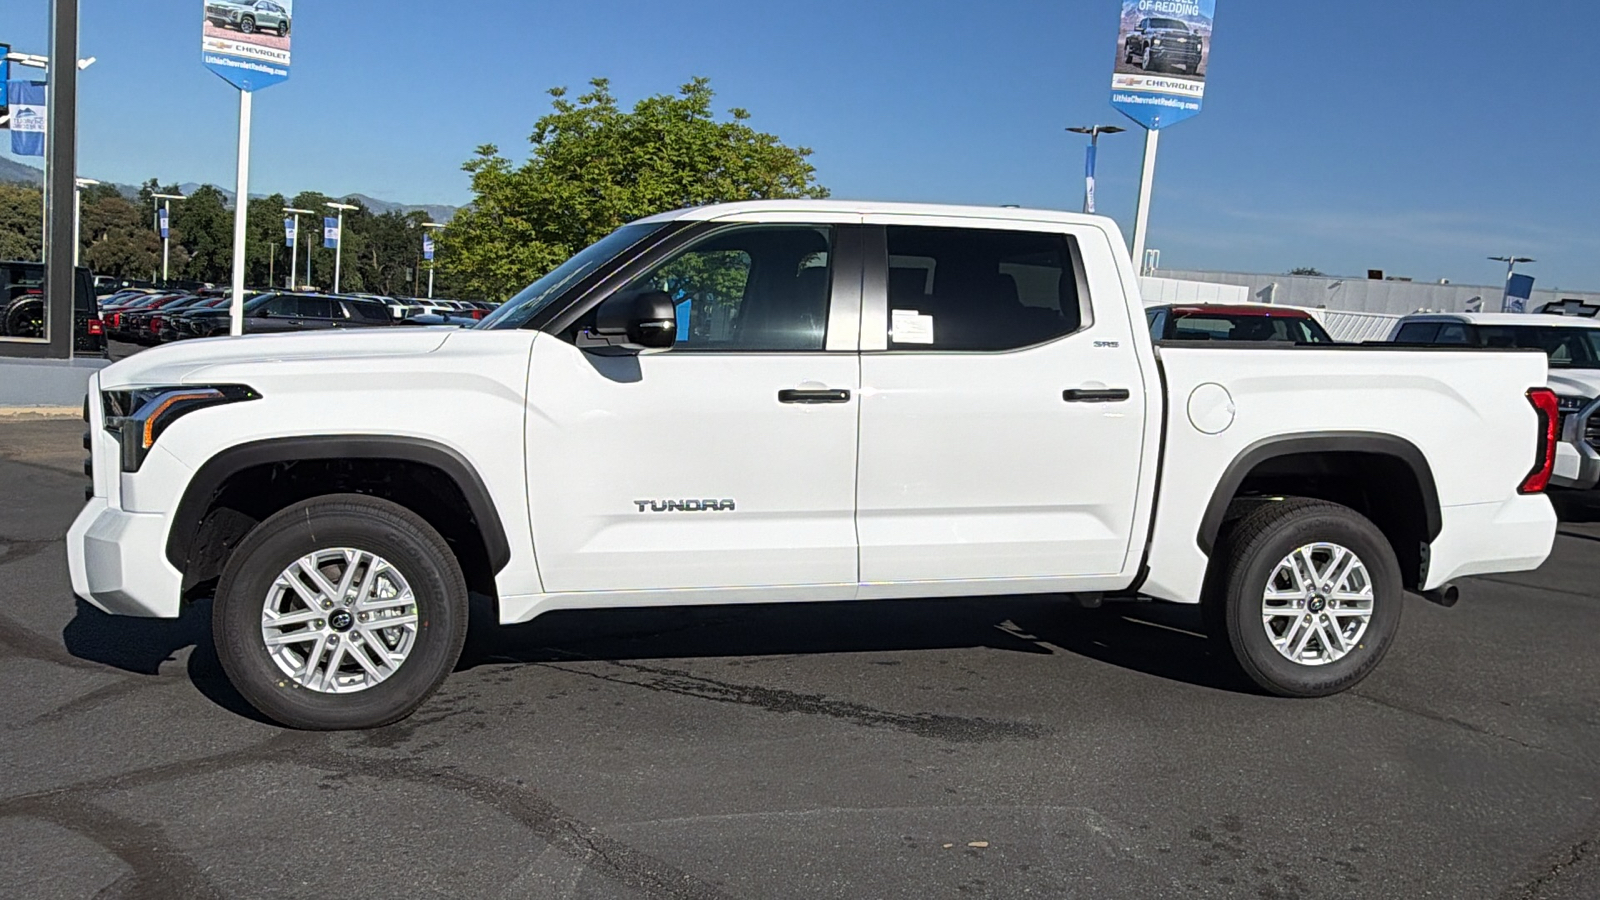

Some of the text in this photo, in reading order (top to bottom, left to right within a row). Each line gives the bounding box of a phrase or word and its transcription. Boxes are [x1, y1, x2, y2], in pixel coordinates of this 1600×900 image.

[1138, 0, 1199, 16] OF REDDING
[235, 44, 287, 59] CHEVROLET
[1146, 79, 1200, 91] CHEVROLET
[1093, 340, 1119, 348] SR5
[633, 499, 735, 512] TUNDRA
